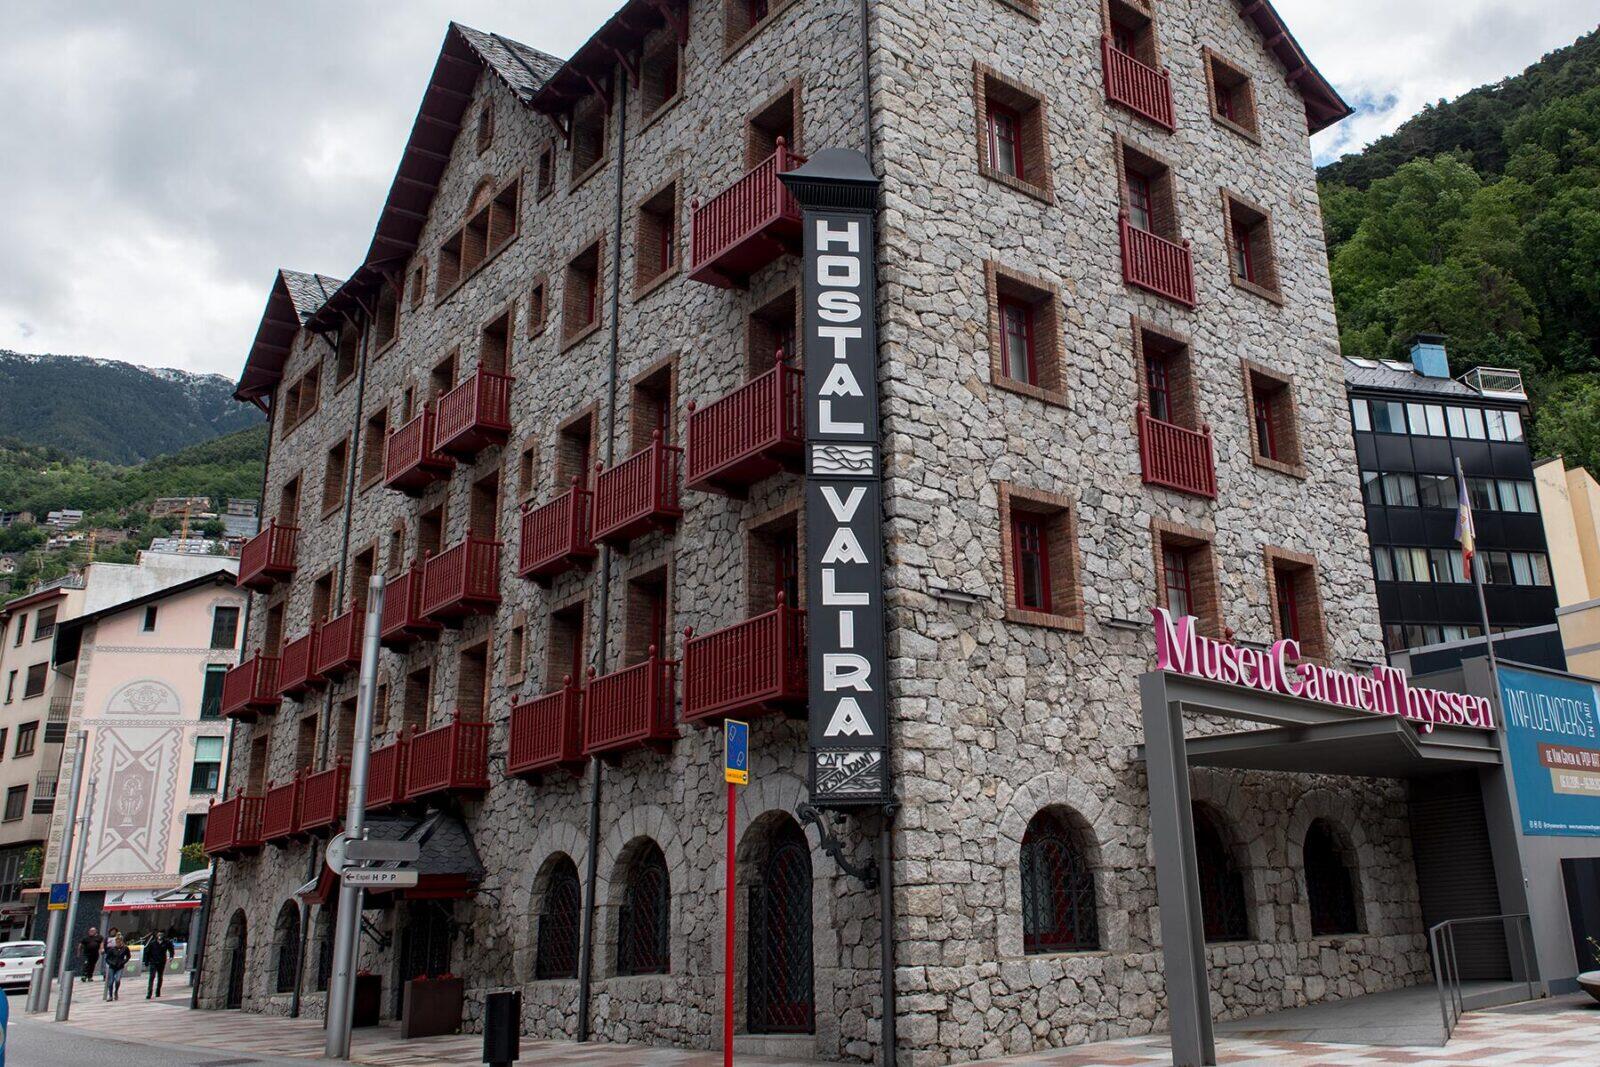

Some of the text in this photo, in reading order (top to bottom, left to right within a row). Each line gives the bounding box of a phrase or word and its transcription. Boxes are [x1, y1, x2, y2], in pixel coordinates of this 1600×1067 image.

[816, 219, 865, 434] HOSTAL
[819, 486, 874, 737] VALIRA
[816, 751, 875, 792] RESTAURANT
